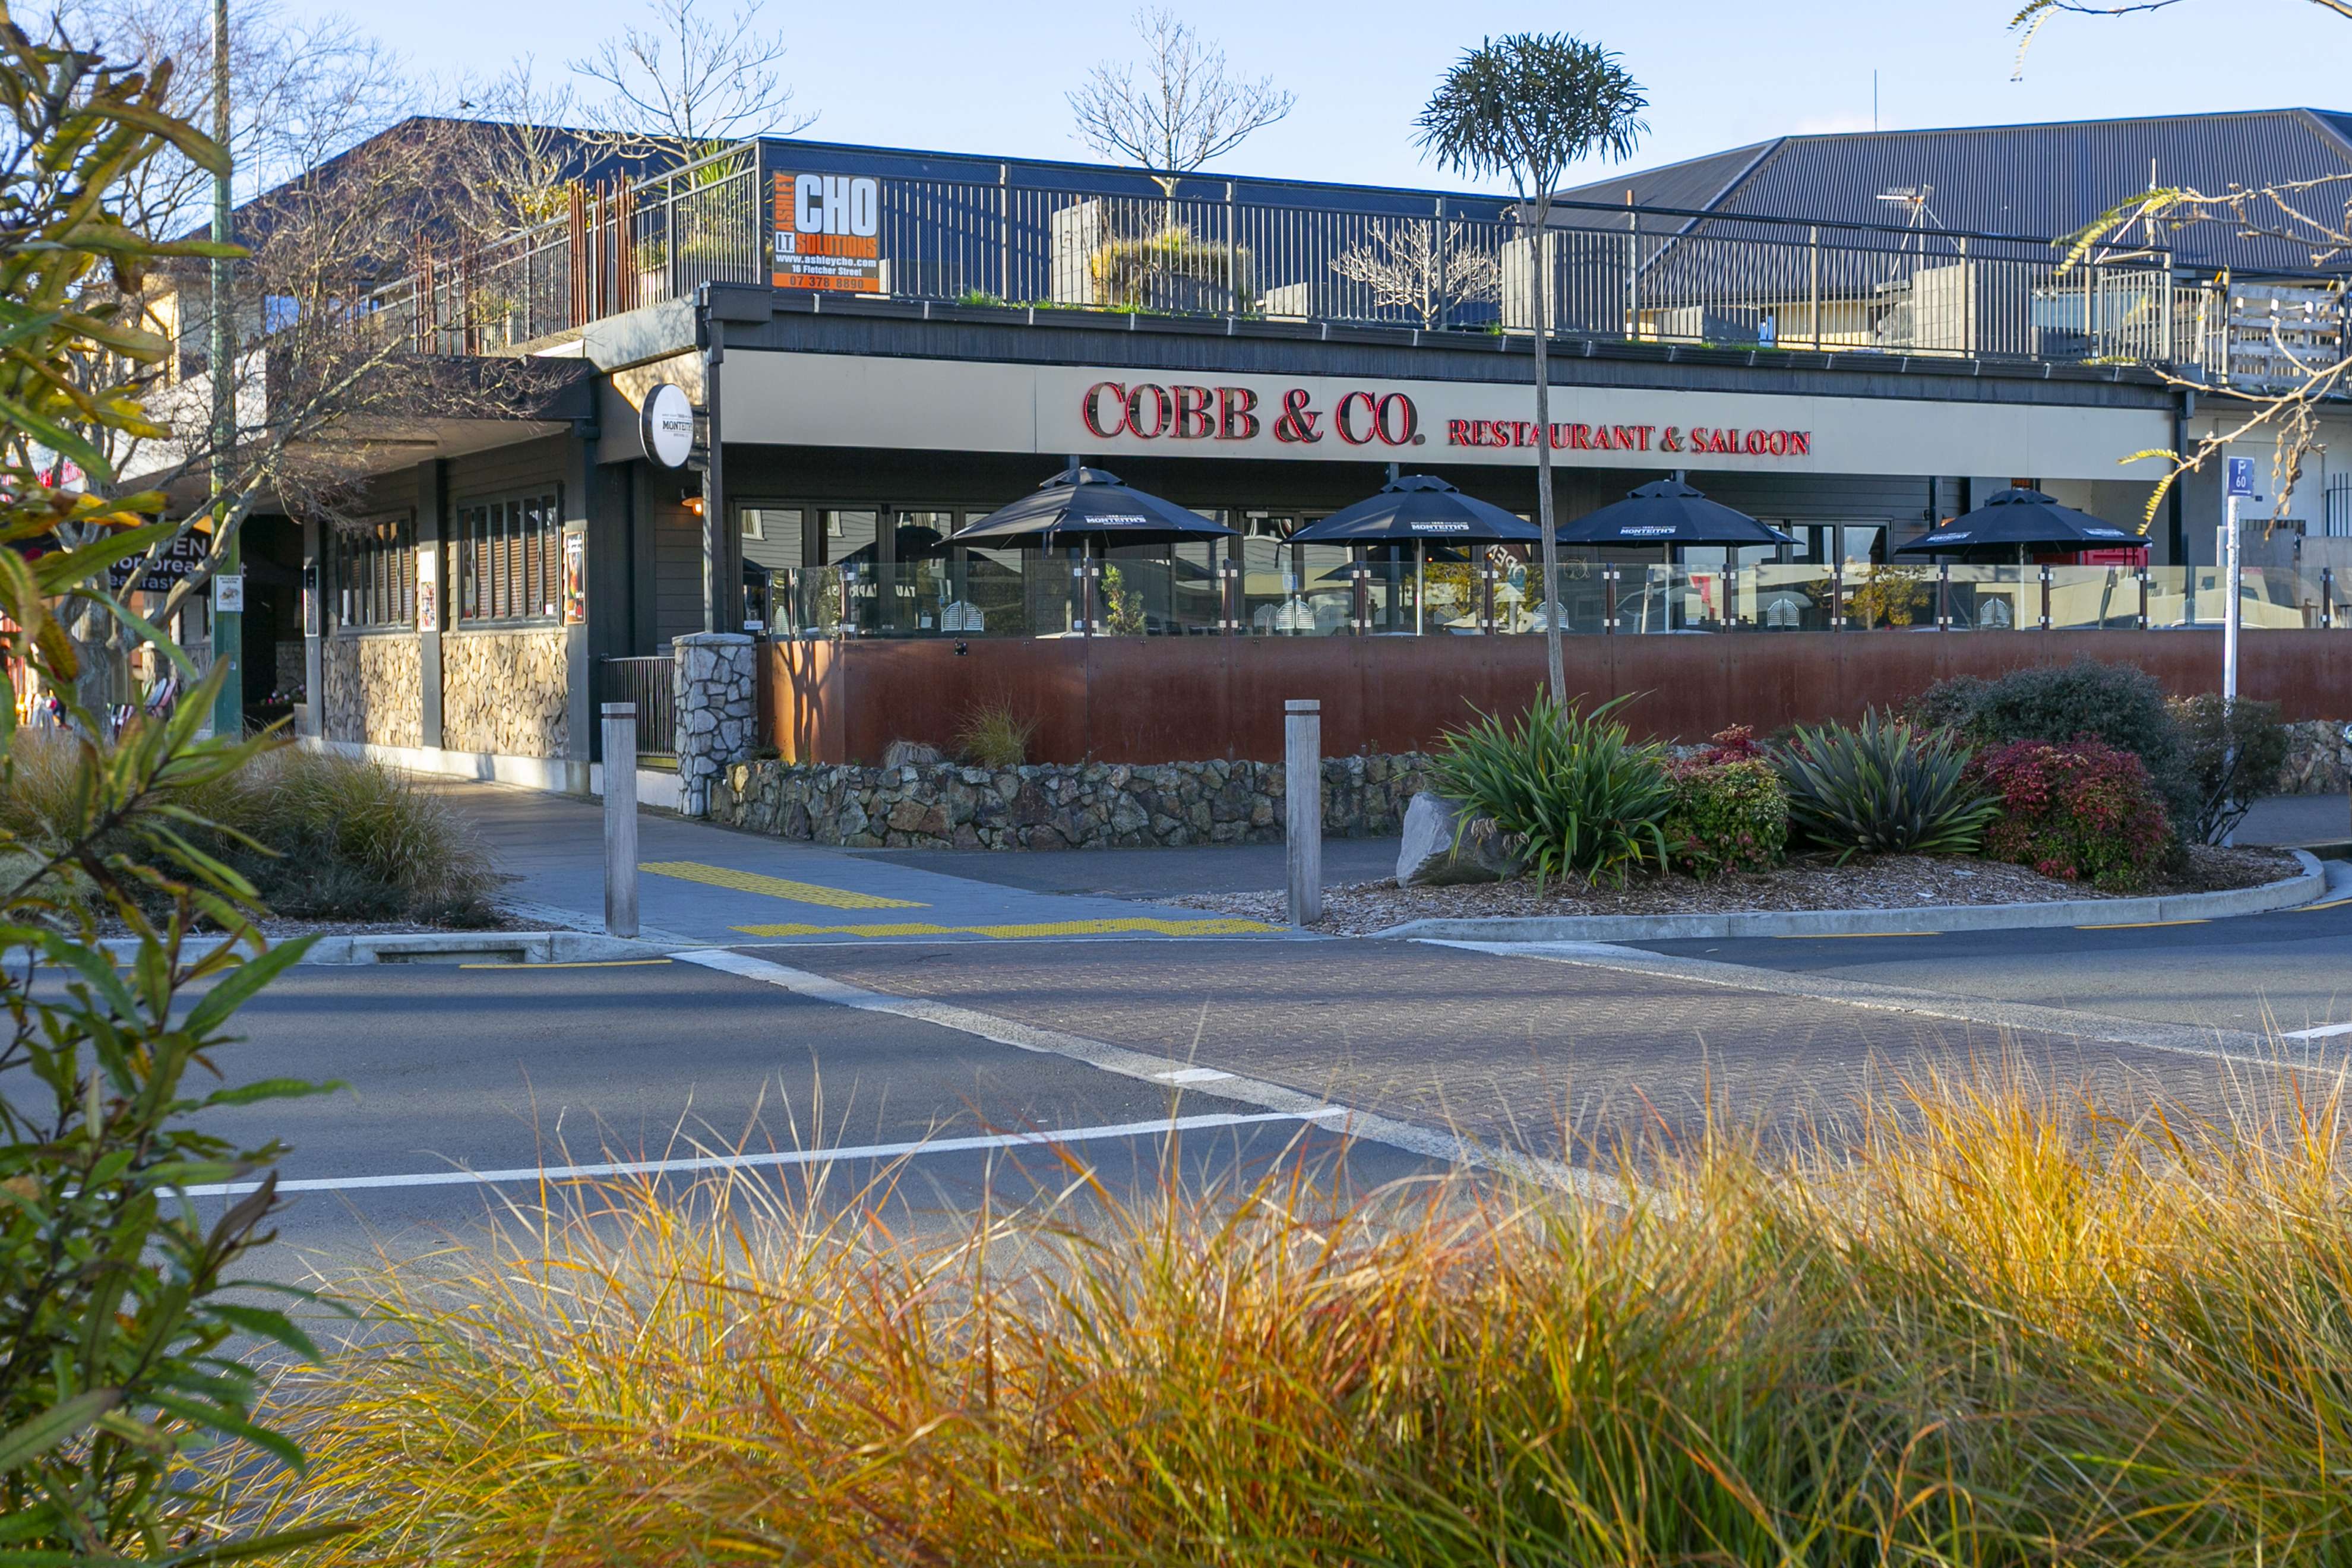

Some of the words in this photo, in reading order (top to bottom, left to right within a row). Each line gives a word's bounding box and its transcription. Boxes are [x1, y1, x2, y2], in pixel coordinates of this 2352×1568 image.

[775, 173, 794, 231] ASHLEY
[795, 174, 877, 237] CHO
[777, 233, 794, 251] I.T.
[796, 233, 877, 258] SOLUTIONS
[776, 254, 877, 267] www.ashleycho.com
[792, 264, 801, 273] 16
[803, 265, 836, 275] Fletcher
[838, 267, 862, 277] Street
[790, 276, 804, 286] 07
[809, 276, 830, 287] 378
[1084, 382, 1260, 440] COBB
[1275, 388, 1324, 444] &
[1336, 391, 1427, 446] CO.
[1660, 426, 1686, 452] &
[1691, 427, 1812, 456] SALOON
[2238, 460, 2246, 475] P
[2236, 476, 2246, 488] 60
